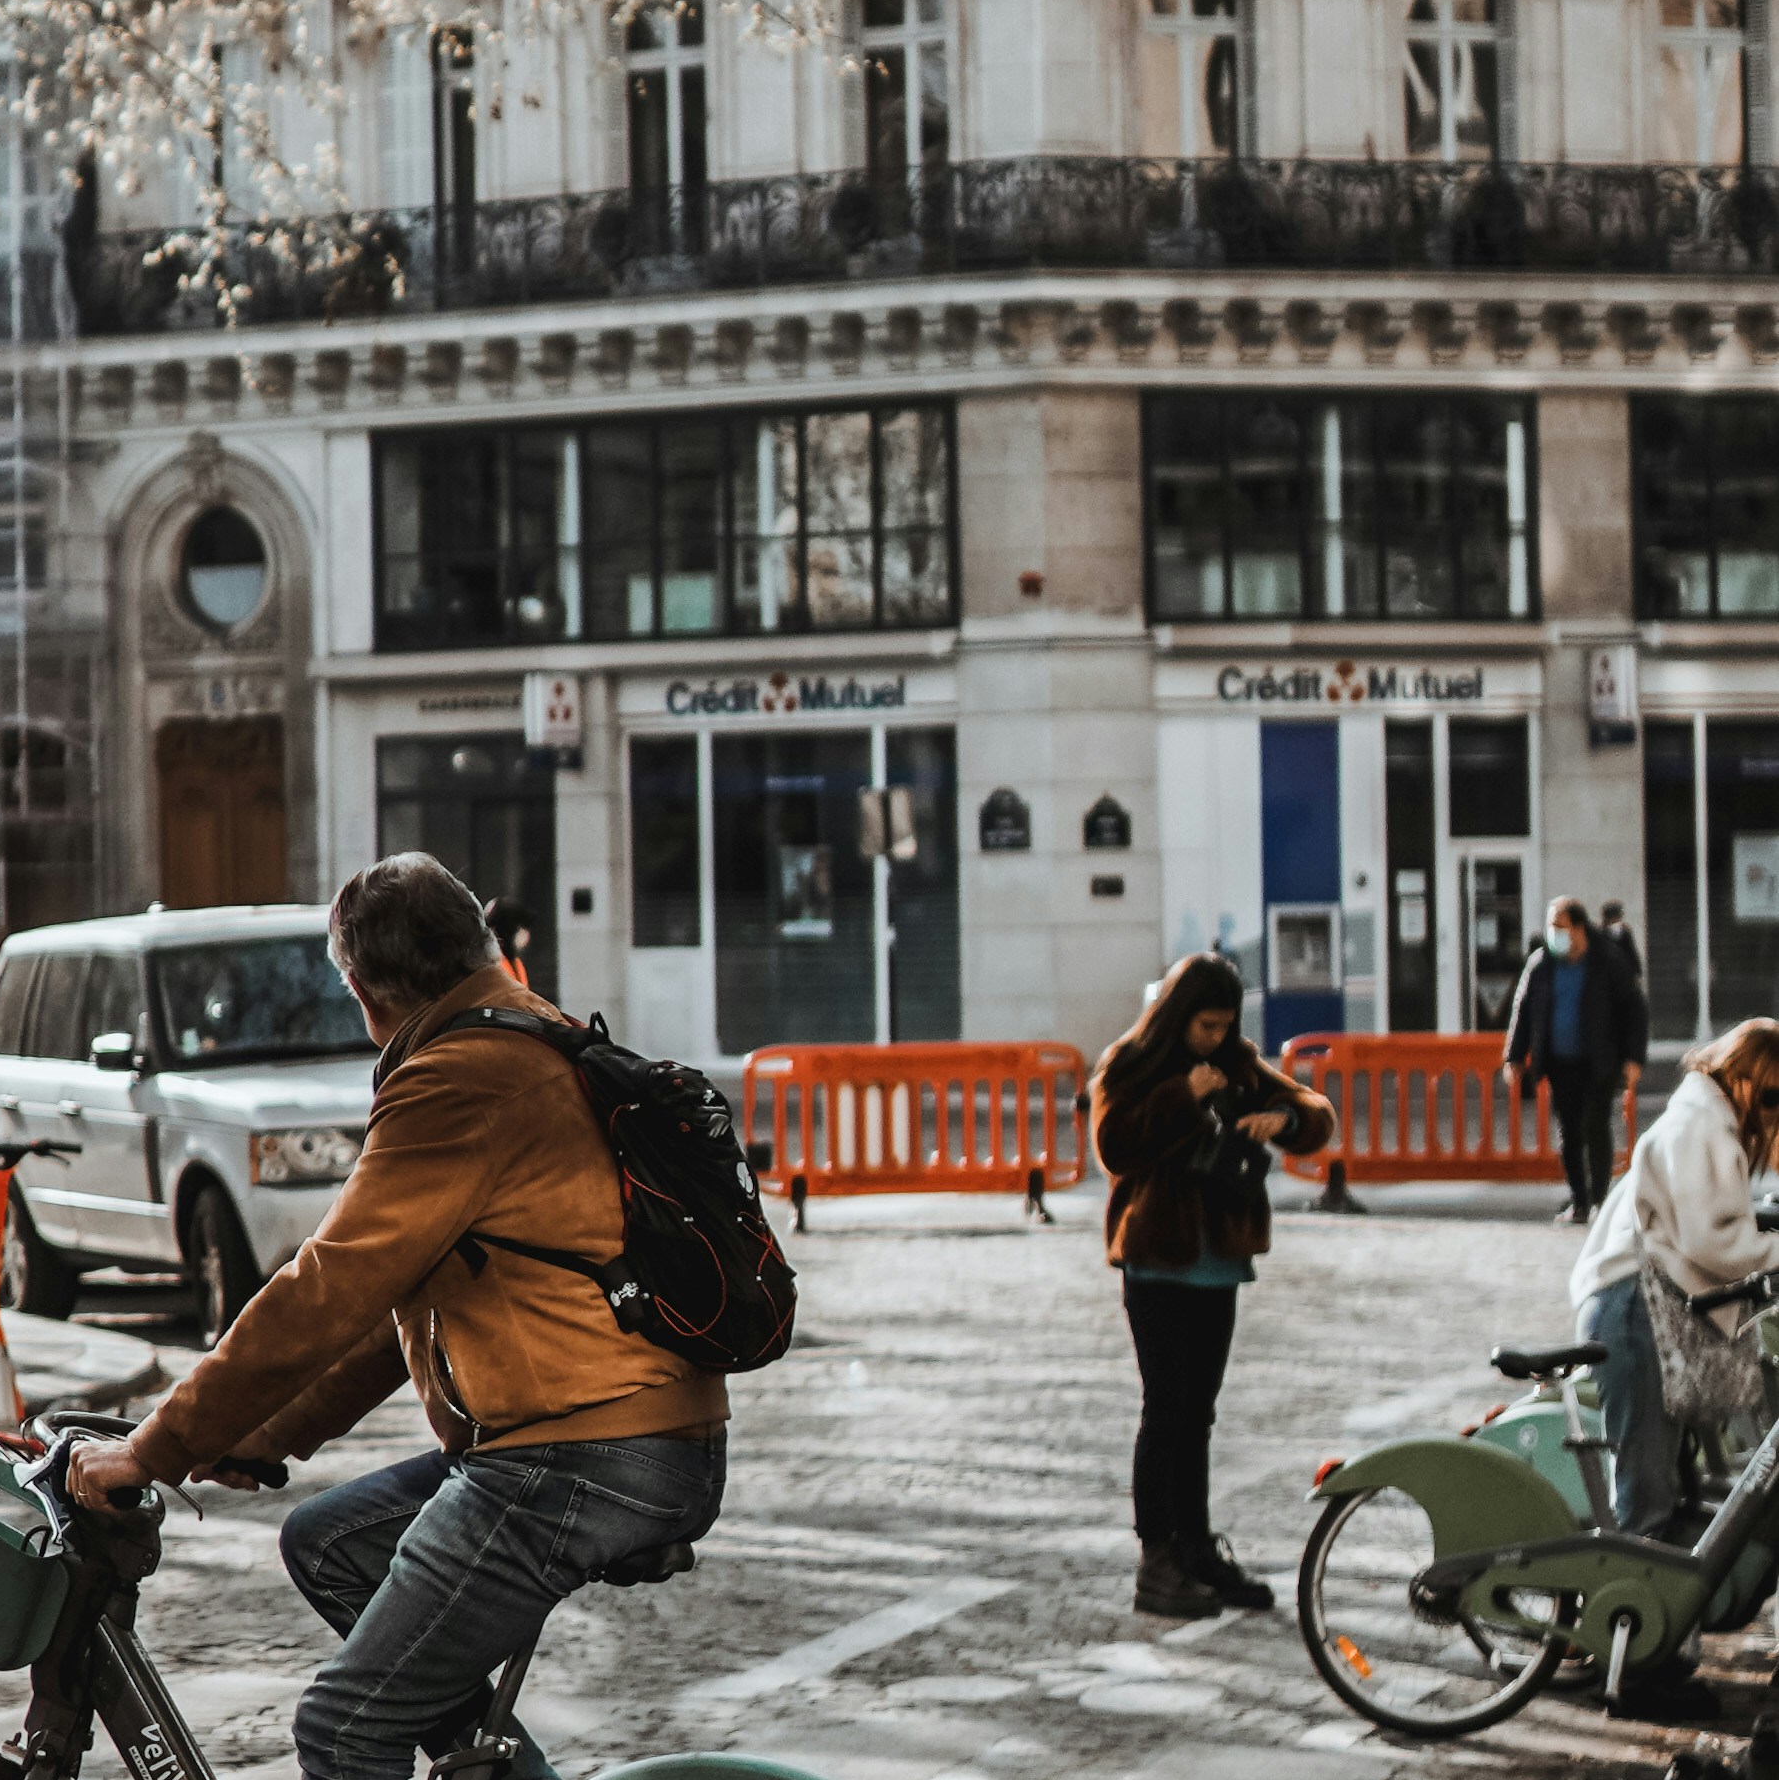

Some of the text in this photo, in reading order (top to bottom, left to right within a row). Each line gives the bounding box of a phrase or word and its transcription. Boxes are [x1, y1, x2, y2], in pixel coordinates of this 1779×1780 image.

[667, 675, 905, 714] Crédit Mutuel
[1219, 664, 1483, 700] Crédit Mutuel
